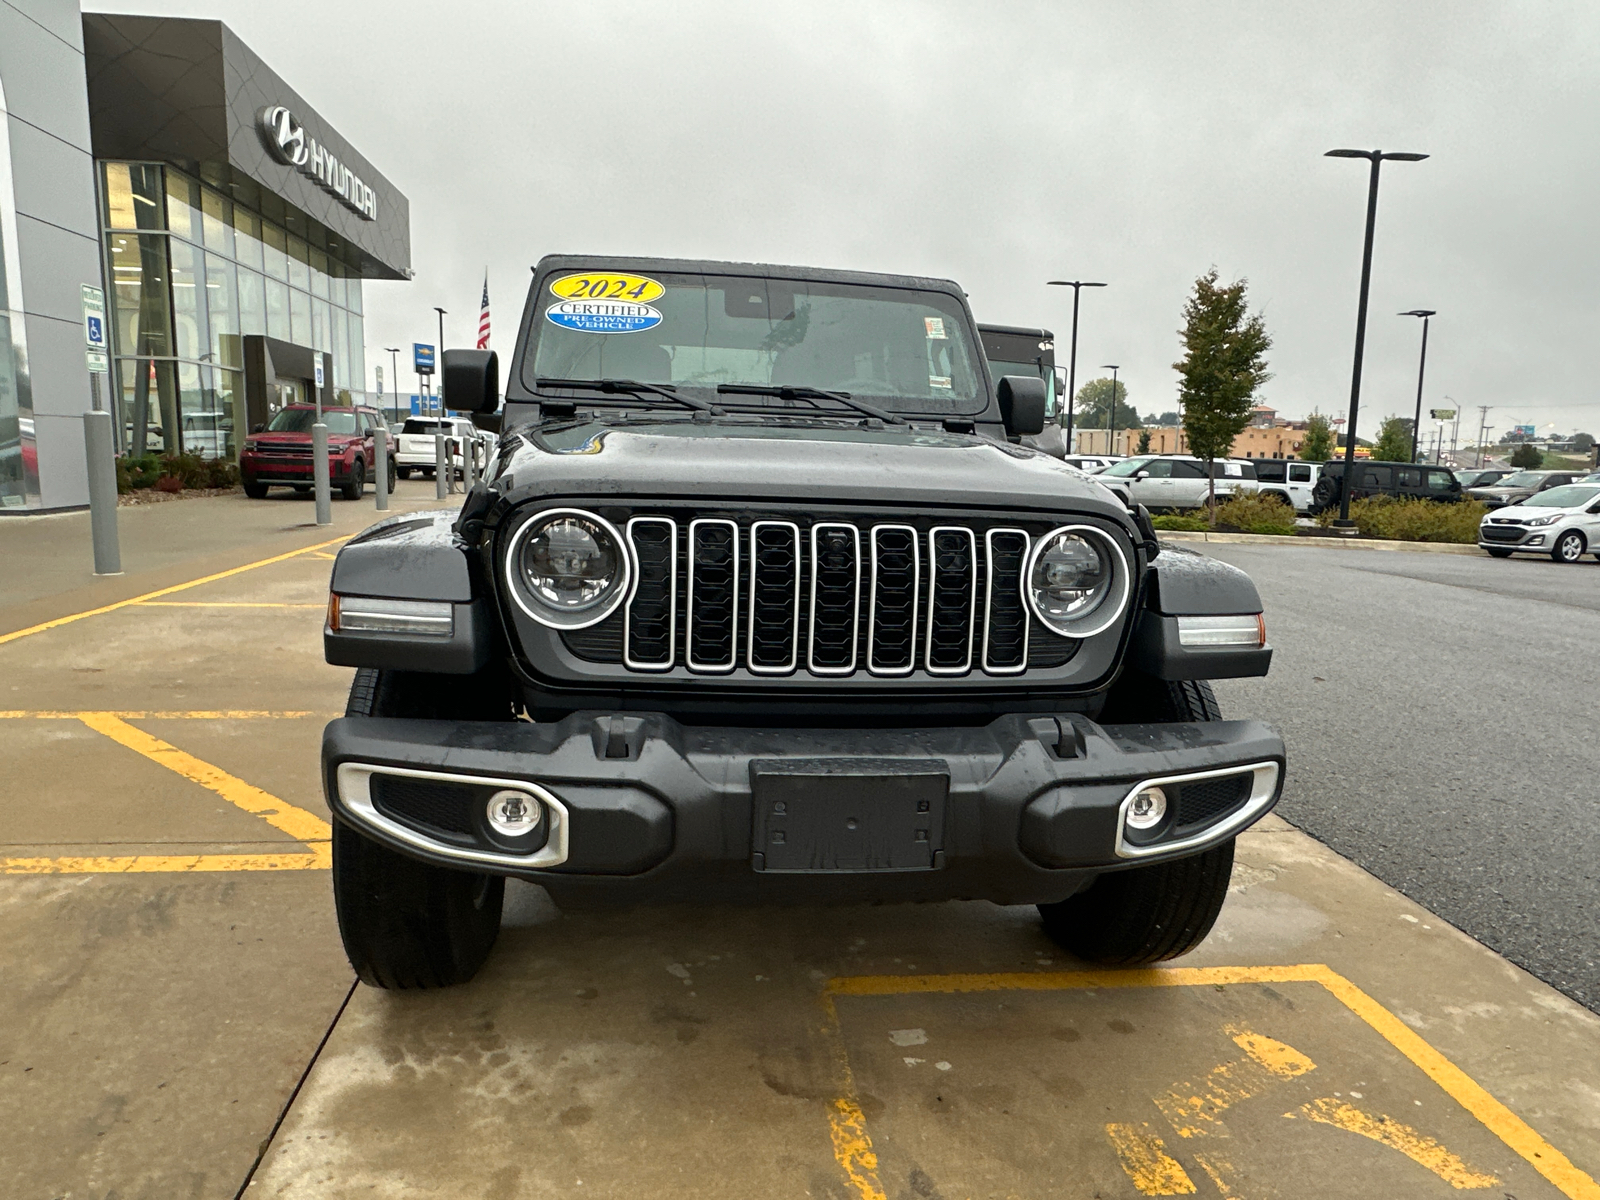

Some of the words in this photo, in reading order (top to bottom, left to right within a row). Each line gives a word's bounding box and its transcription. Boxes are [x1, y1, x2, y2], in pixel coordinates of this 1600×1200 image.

[310, 138, 377, 220] HYUNDAI
[567, 279, 650, 299] 2024
[560, 303, 650, 317] CERTIFIED
[564, 315, 645, 324] PRE-OWNED
[576, 321, 634, 330] VEHICLE
